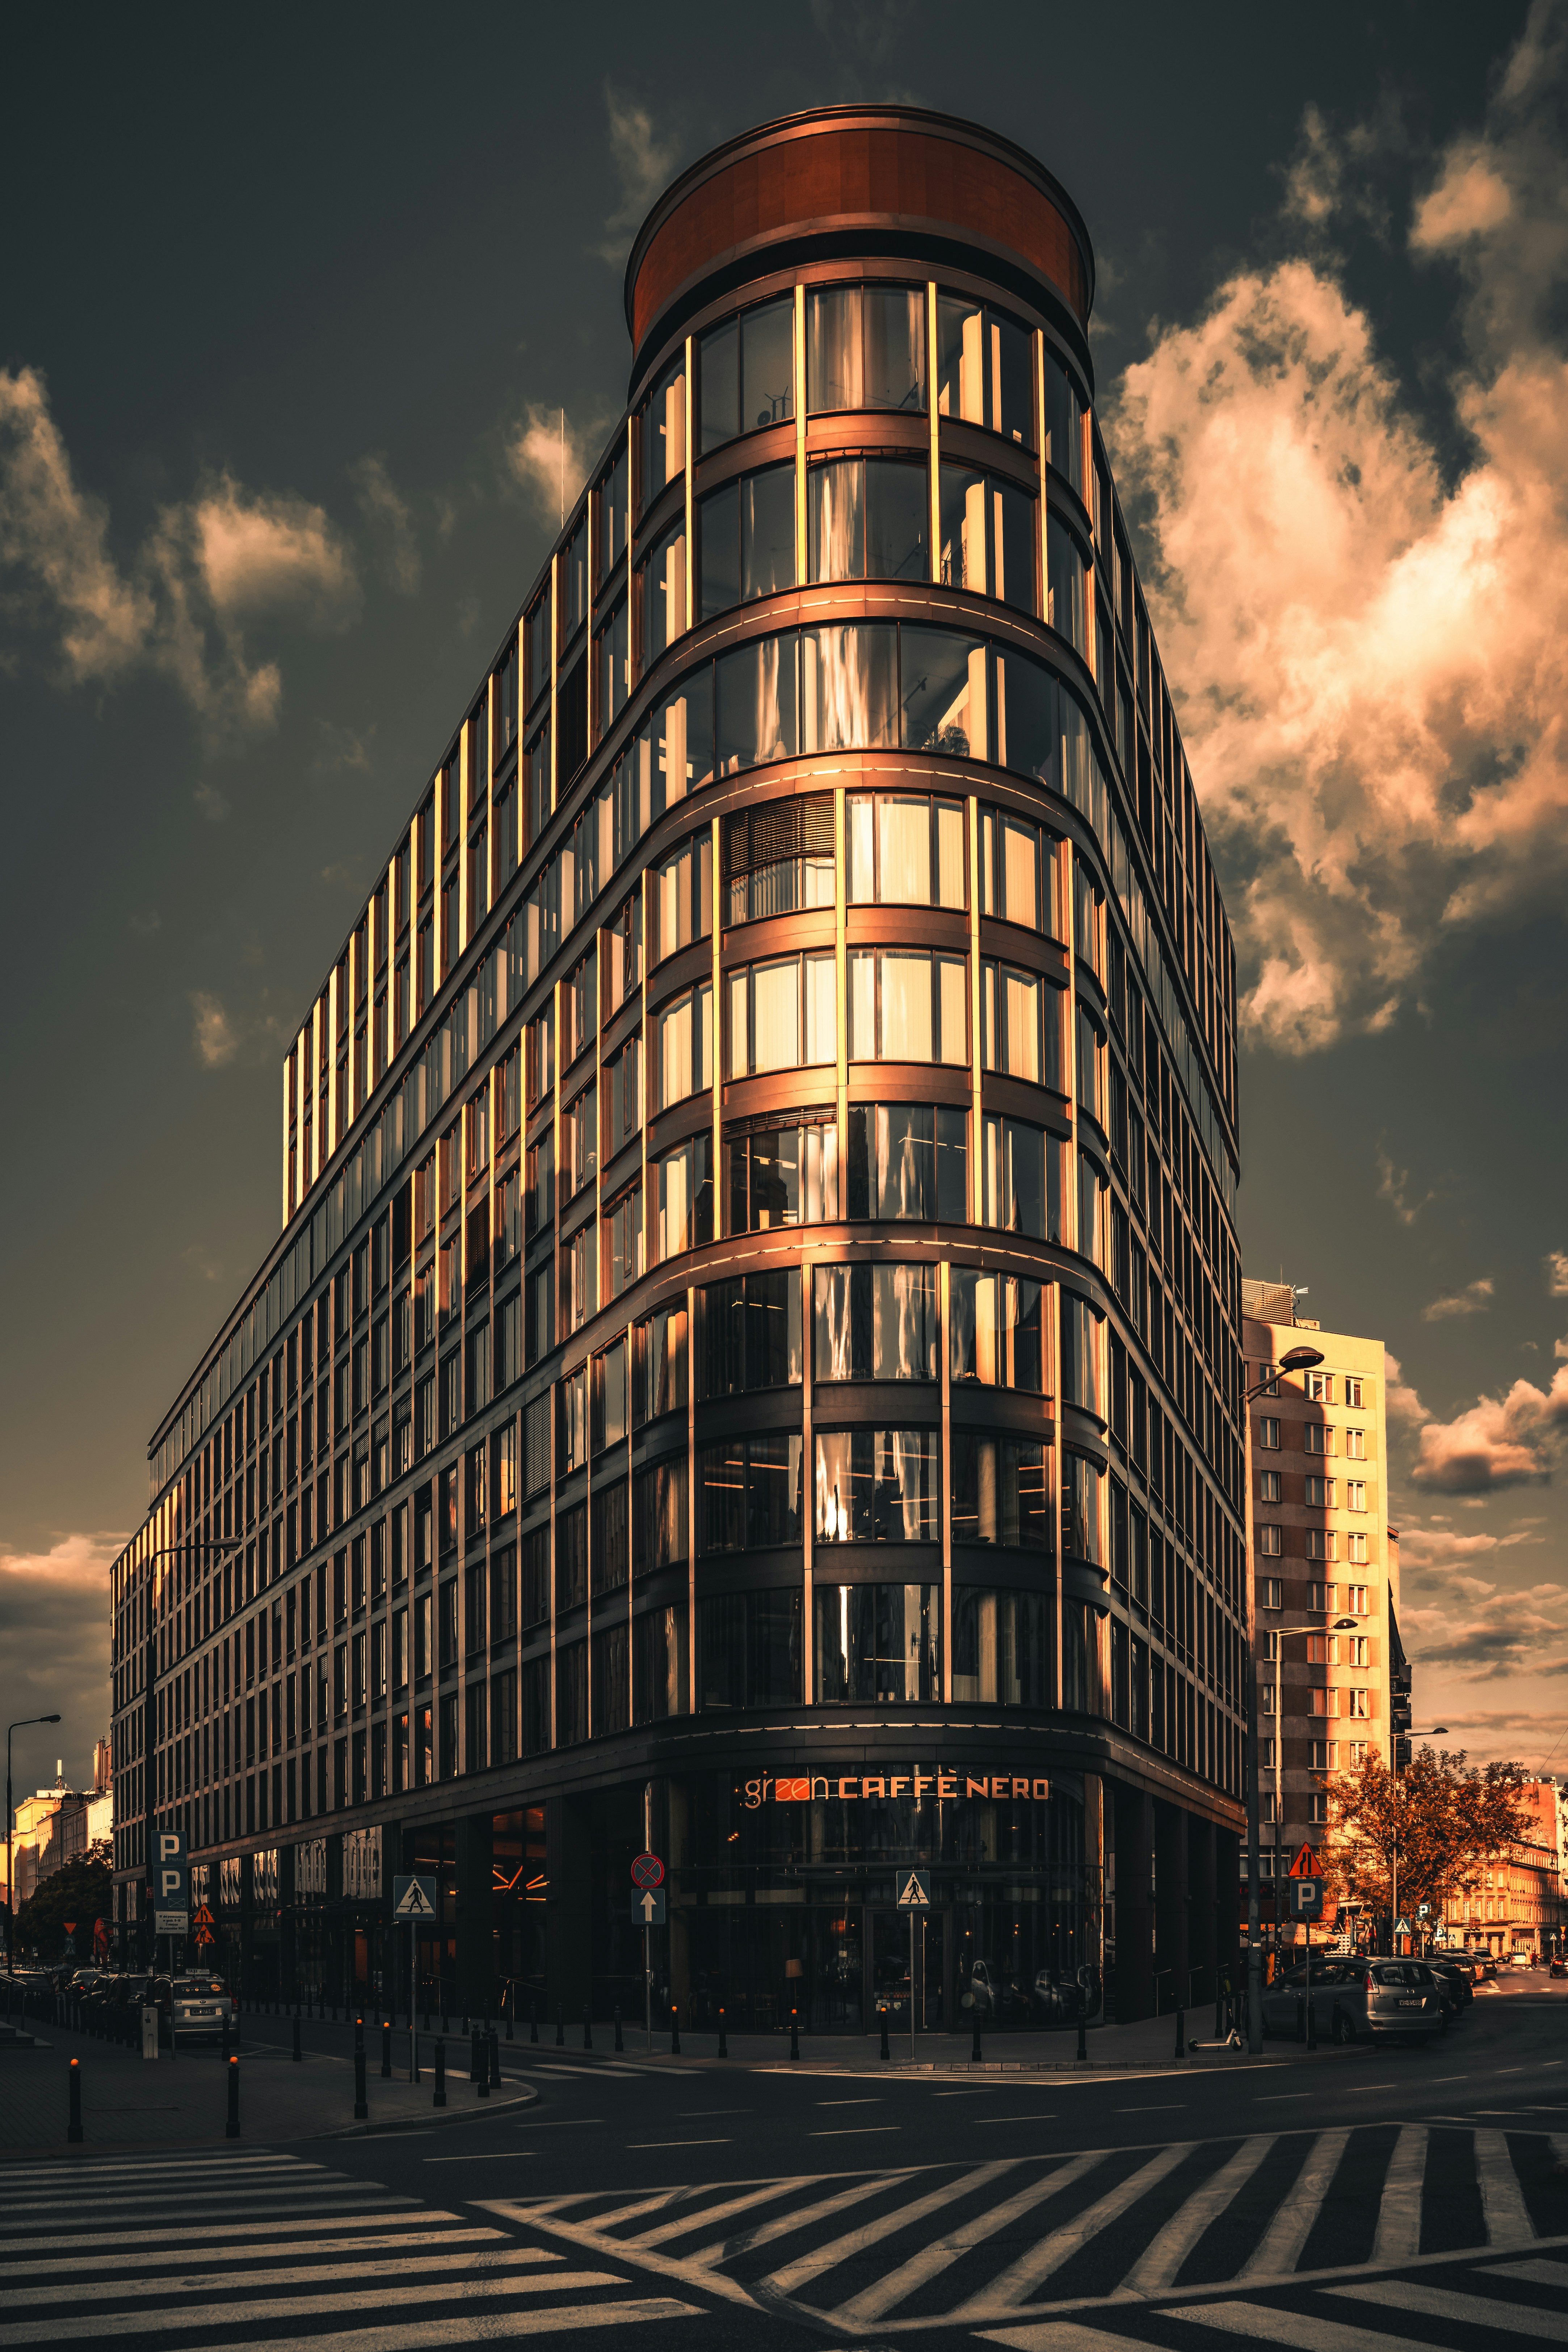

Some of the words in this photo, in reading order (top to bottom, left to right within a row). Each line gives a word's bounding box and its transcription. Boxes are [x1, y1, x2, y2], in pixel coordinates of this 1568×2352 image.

[745, 1777, 829, 1809] green
[839, 1768, 957, 1798] CAFFÈ
[967, 1777, 1048, 1799] NERO
[160, 1835, 179, 1861] P
[162, 1871, 180, 1897] P
[1298, 1883, 1315, 1909] P
[1419, 1905, 1428, 1916] P
[1437, 1929, 1443, 1937] P
